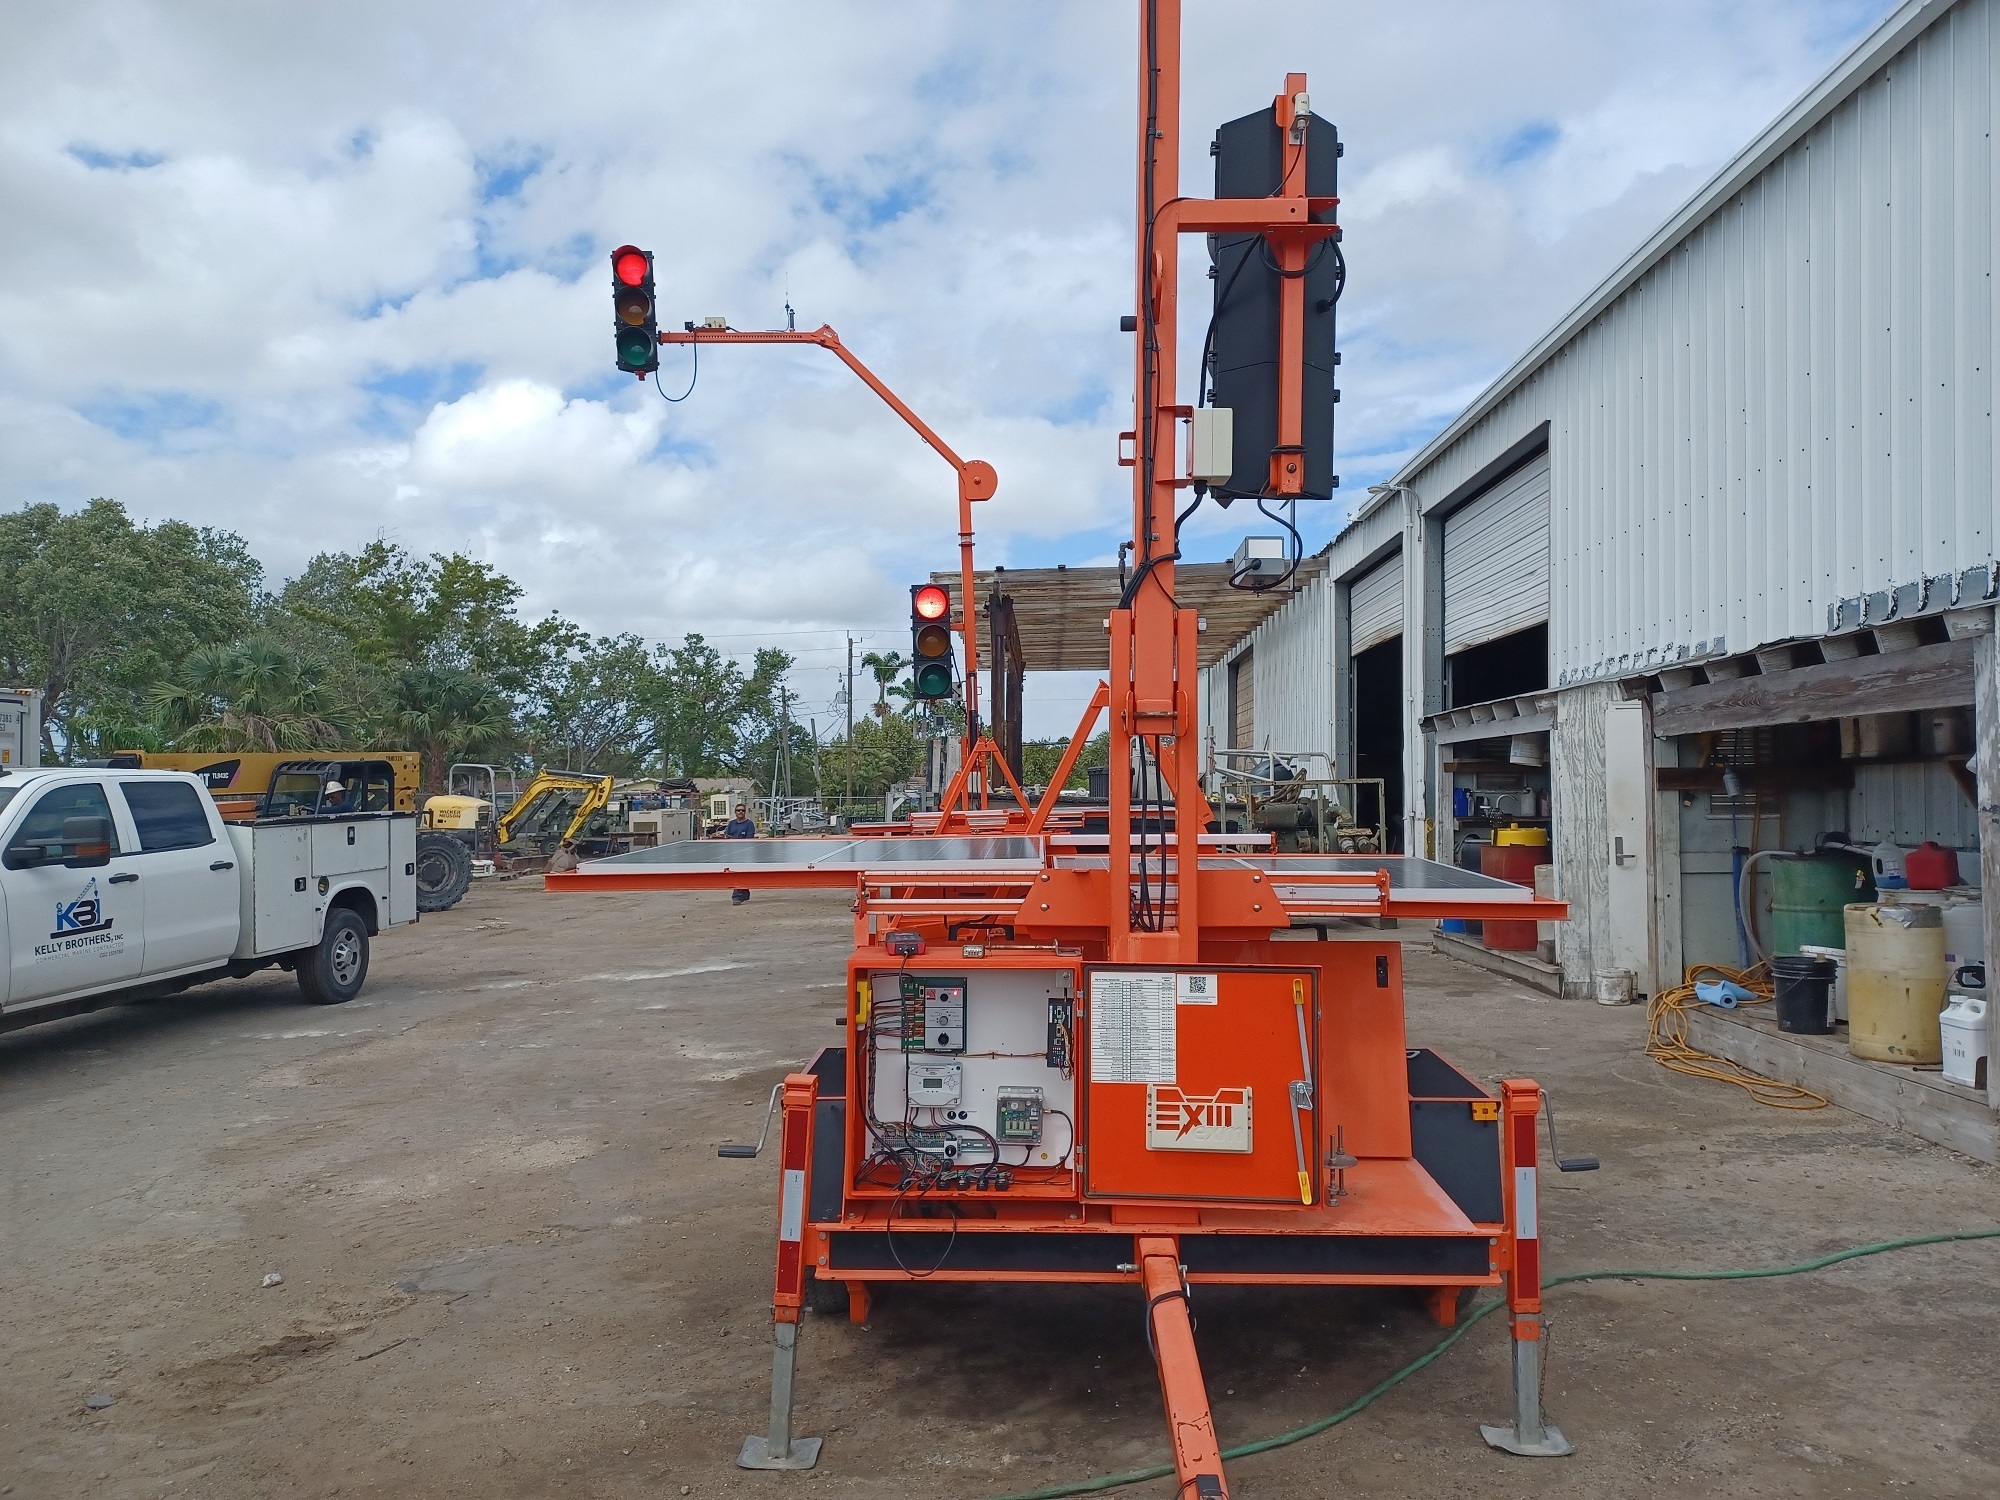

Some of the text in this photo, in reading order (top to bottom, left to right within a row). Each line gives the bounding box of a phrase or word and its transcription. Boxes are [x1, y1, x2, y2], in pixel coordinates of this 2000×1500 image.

[34, 942, 62, 956] KELLY
[65, 933, 113, 949] BROTHERS,
[36, 941, 125, 964] COMMERCIAL MARINE CONTRACTOR
